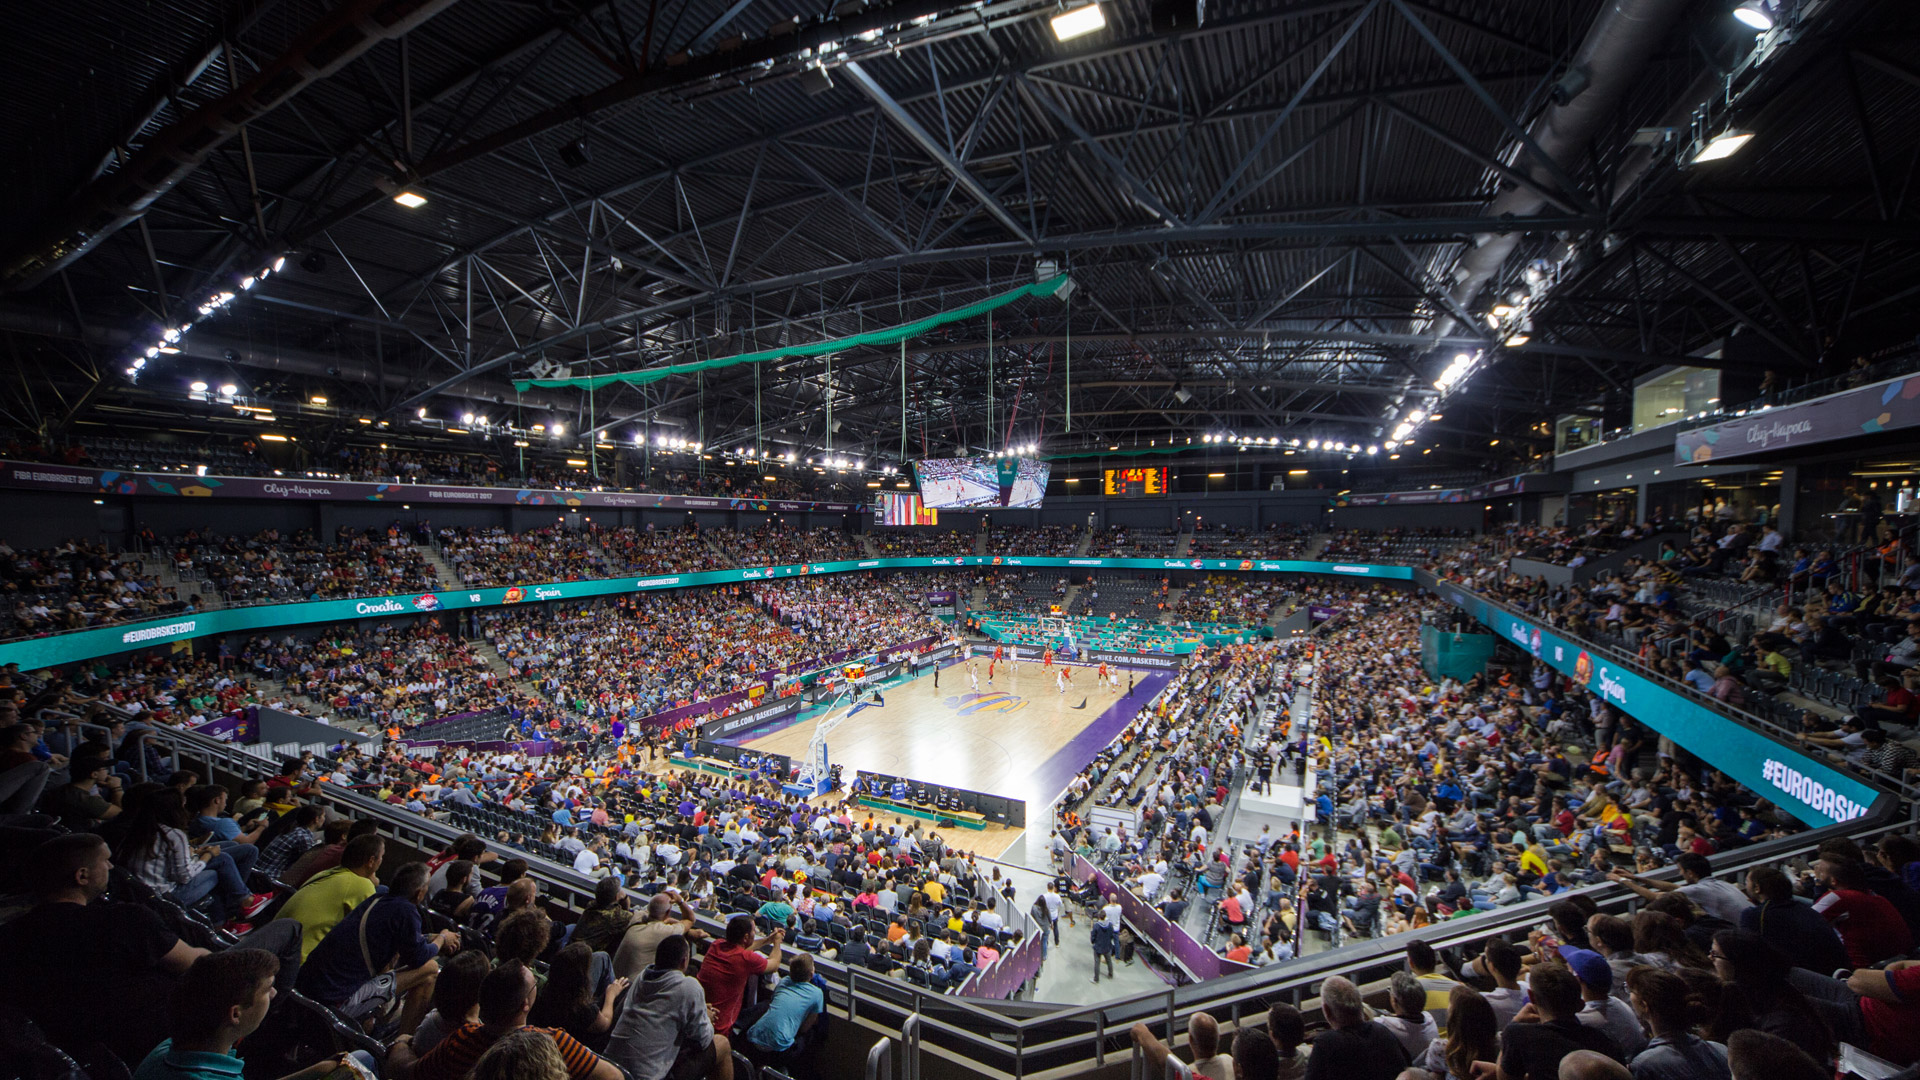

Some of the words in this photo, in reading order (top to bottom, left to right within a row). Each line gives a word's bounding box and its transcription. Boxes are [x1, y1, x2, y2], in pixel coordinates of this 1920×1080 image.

[1747, 420, 1812, 447] Cluj-Napoca
[14, 470, 32, 481] FIBA
[33, 472, 77, 484] EUROBASKET
[78, 475, 94, 485] 2017
[263, 484, 331, 496] Cluj-Napoca
[429, 490, 442, 498] FIBA
[444, 491, 479, 499] EUROBASKET
[743, 570, 761, 579] Croatia
[813, 565, 825, 574] Spain
[1260, 562, 1280, 571] Spain
[356, 599, 404, 614] Croatia
[469, 594, 481, 603] VS
[535, 587, 562, 600] Spain
[123, 621, 196, 643] #EUROBASKET2017
[1599, 667, 1627, 704] Spain
[724, 704, 787, 732] NIKE.COM/BASKETBALL
